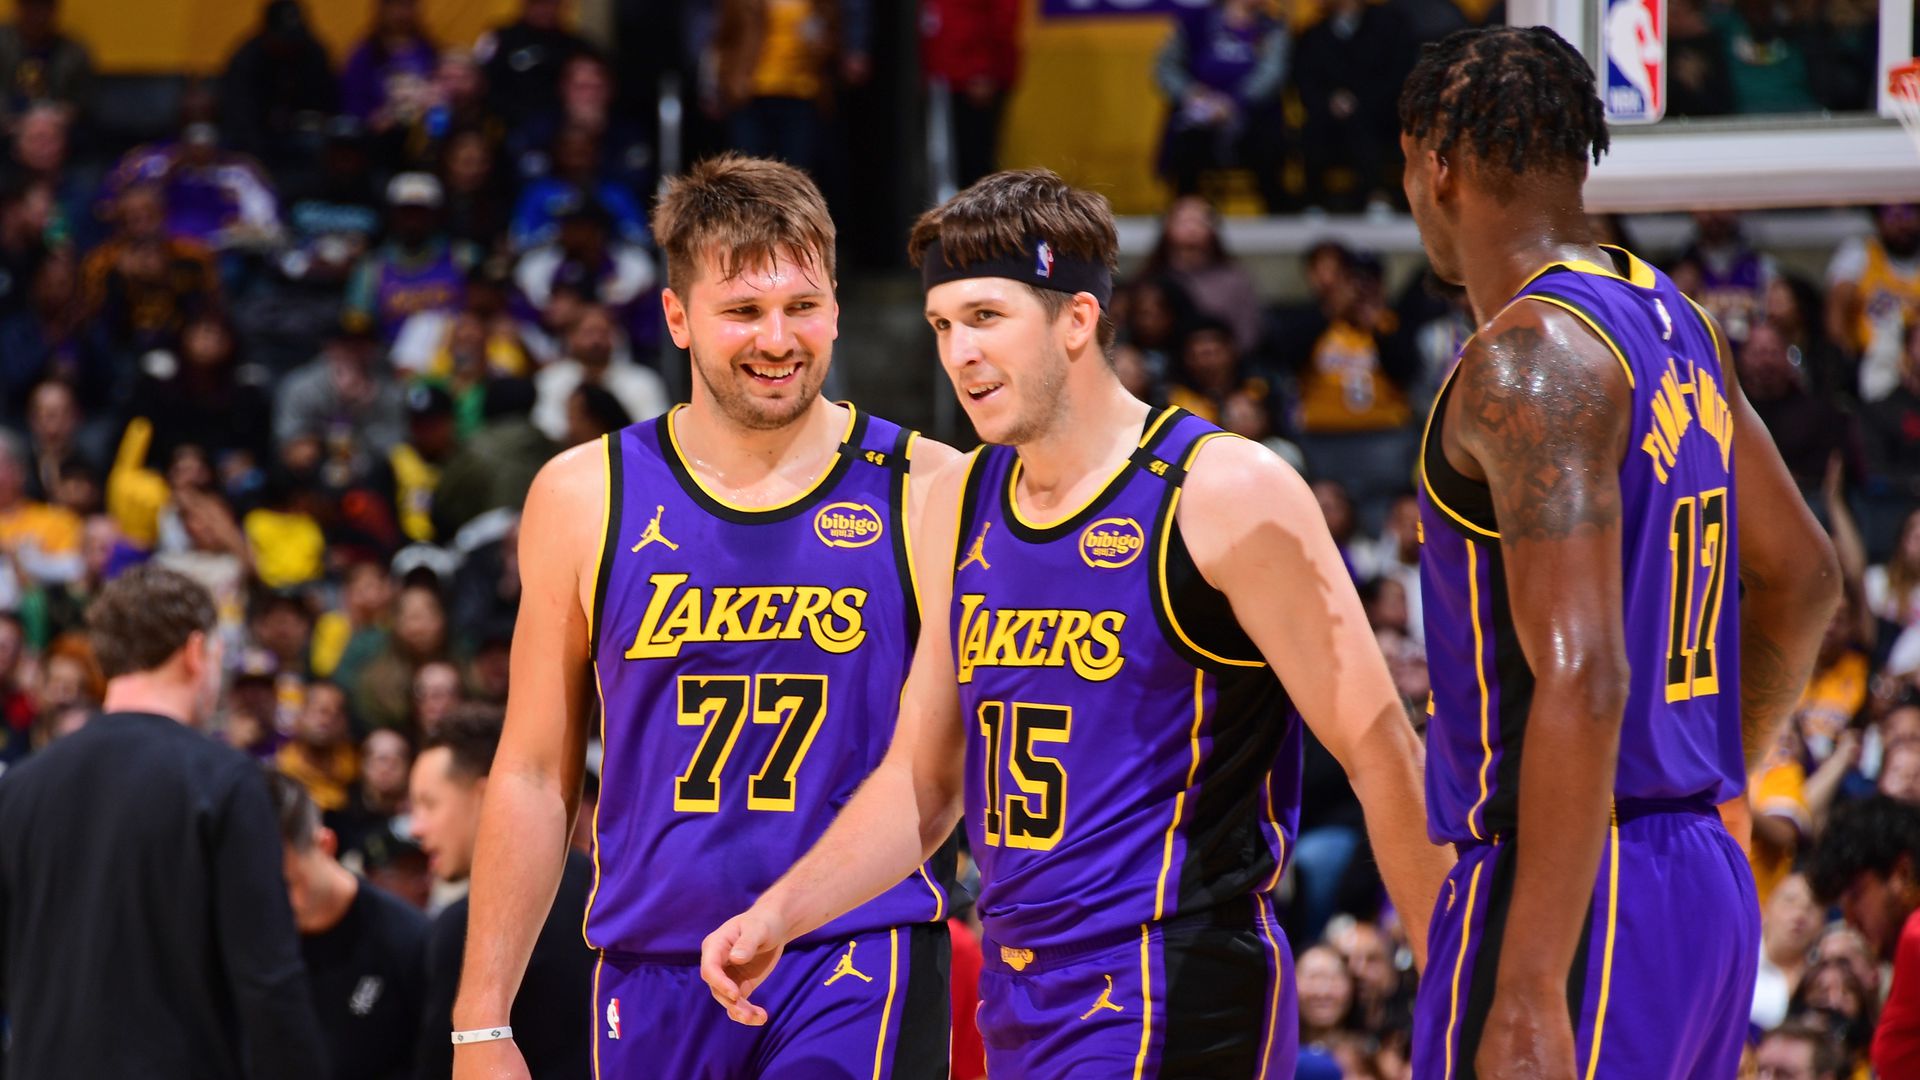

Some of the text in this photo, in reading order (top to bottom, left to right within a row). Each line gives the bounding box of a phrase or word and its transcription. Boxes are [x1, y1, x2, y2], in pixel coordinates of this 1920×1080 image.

[865, 450, 885, 466] 44
[1148, 460, 1170, 476] 44
[820, 513, 879, 536] bibigo
[1085, 530, 1140, 554] bibigo
[624, 573, 869, 660] LAKERS
[957, 593, 1128, 684] LAKERS
[1665, 487, 1727, 704] 17
[673, 673, 829, 813] 77
[977, 700, 1073, 851] 15
